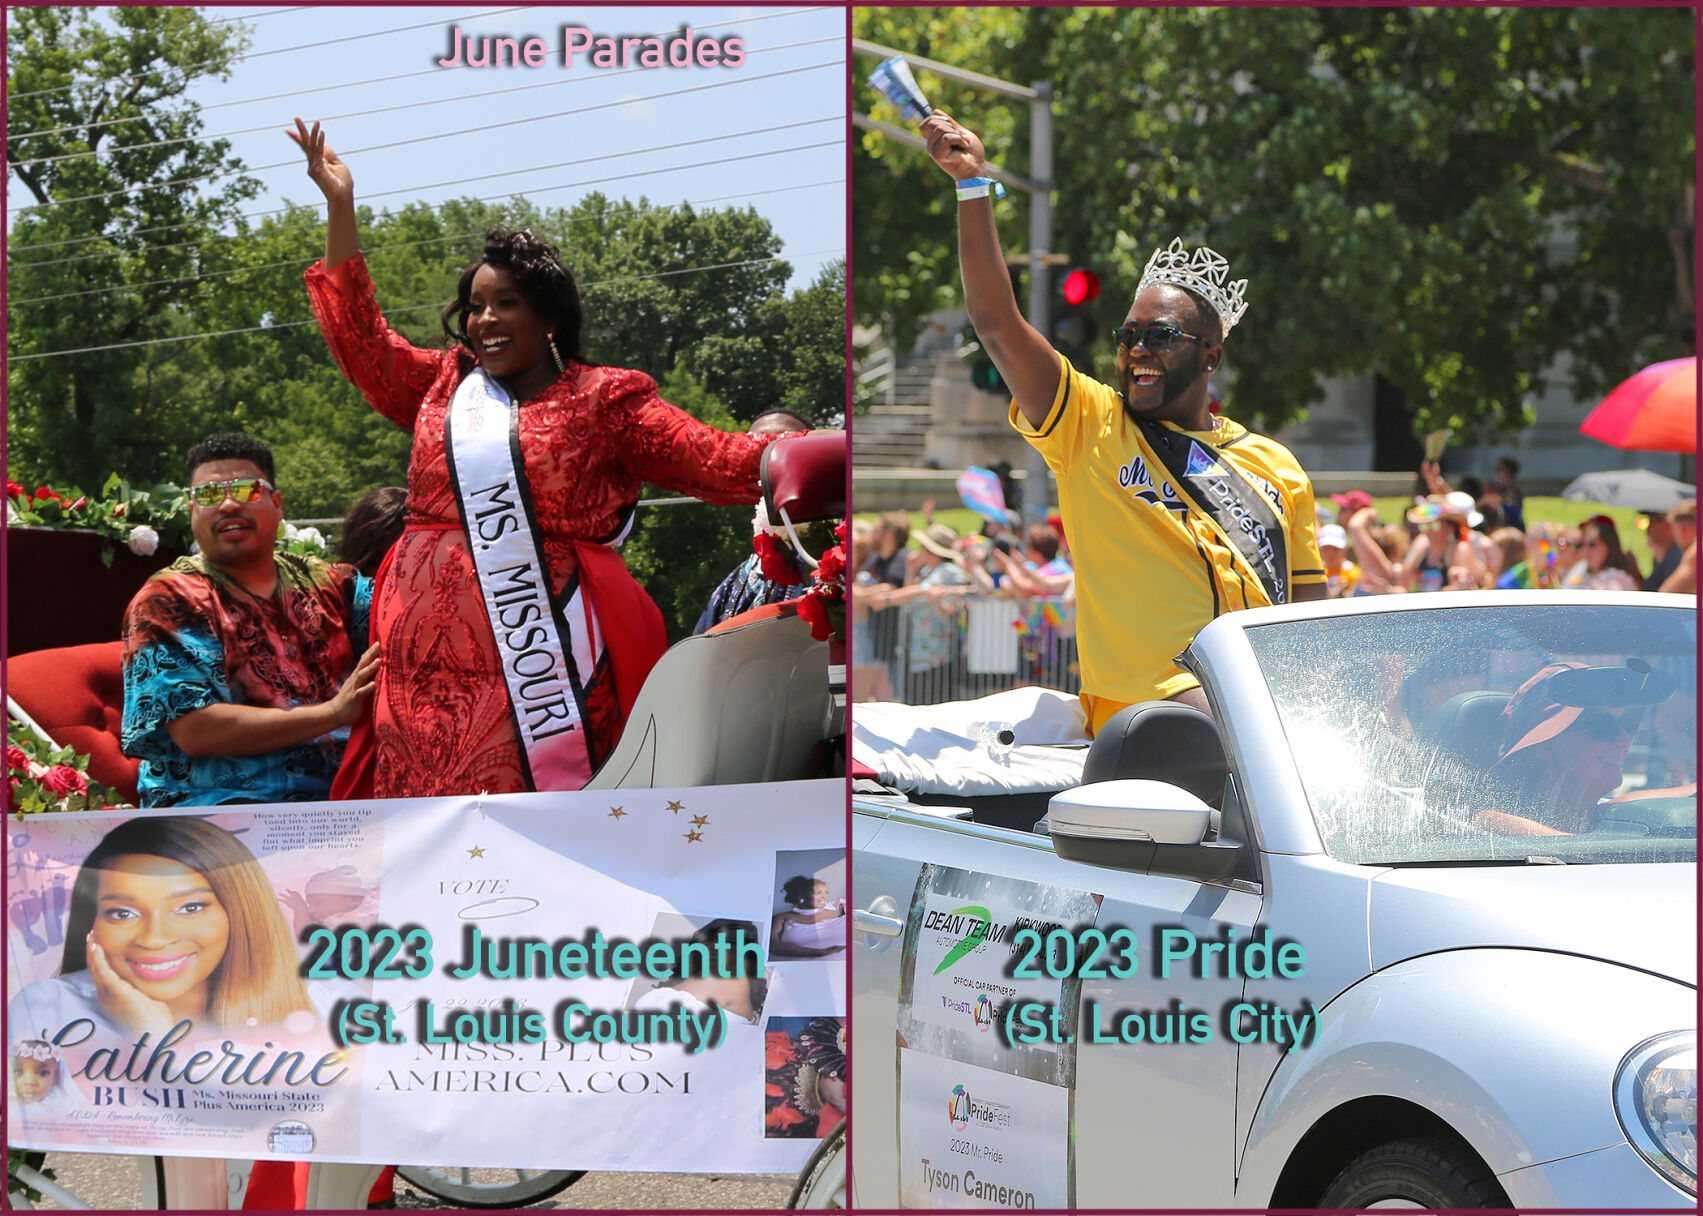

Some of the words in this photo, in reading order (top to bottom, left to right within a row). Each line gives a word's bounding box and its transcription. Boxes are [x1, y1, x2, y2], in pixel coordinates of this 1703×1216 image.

[470, 481, 518, 550] MS.
[1209, 480, 1276, 573] PrideSTL
[488, 562, 575, 743] MISSOURI
[438, 879, 510, 896] VOTE
[924, 911, 965, 934] DEAN
[965, 918, 1007, 943] TEAM
[936, 936, 968, 951] AUTOMOTIVE
[968, 942, 987, 955] GROUP
[954, 976, 974, 990] OFFICIAL
[976, 981, 986, 991] CAR
[986, 983, 1007, 996] PARTNER
[1009, 988, 1016, 997] OF
[948, 998, 971, 1014] PrideSTL
[41, 1018, 348, 1087] Catherine
[414, 1039, 524, 1061] MISS.
[540, 1039, 654, 1061] PLUS
[374, 1070, 692, 1095] AMERICA.COM
[93, 1086, 186, 1110] BUSH
[192, 1090, 214, 1100] Ms.
[219, 1090, 277, 1100] Missouri
[282, 1091, 320, 1101] State
[193, 1101, 222, 1110] Plus
[227, 1101, 285, 1111] America
[289, 1102, 325, 1113] 2023
[971, 1103, 1011, 1127] PrideFest
[950, 1138, 970, 1153] 2023
[971, 1144, 982, 1158] Mr.
[984, 1147, 1003, 1163] Pride
[922, 1158, 959, 1192] Tyson
[964, 1170, 1035, 1210] Cameron
